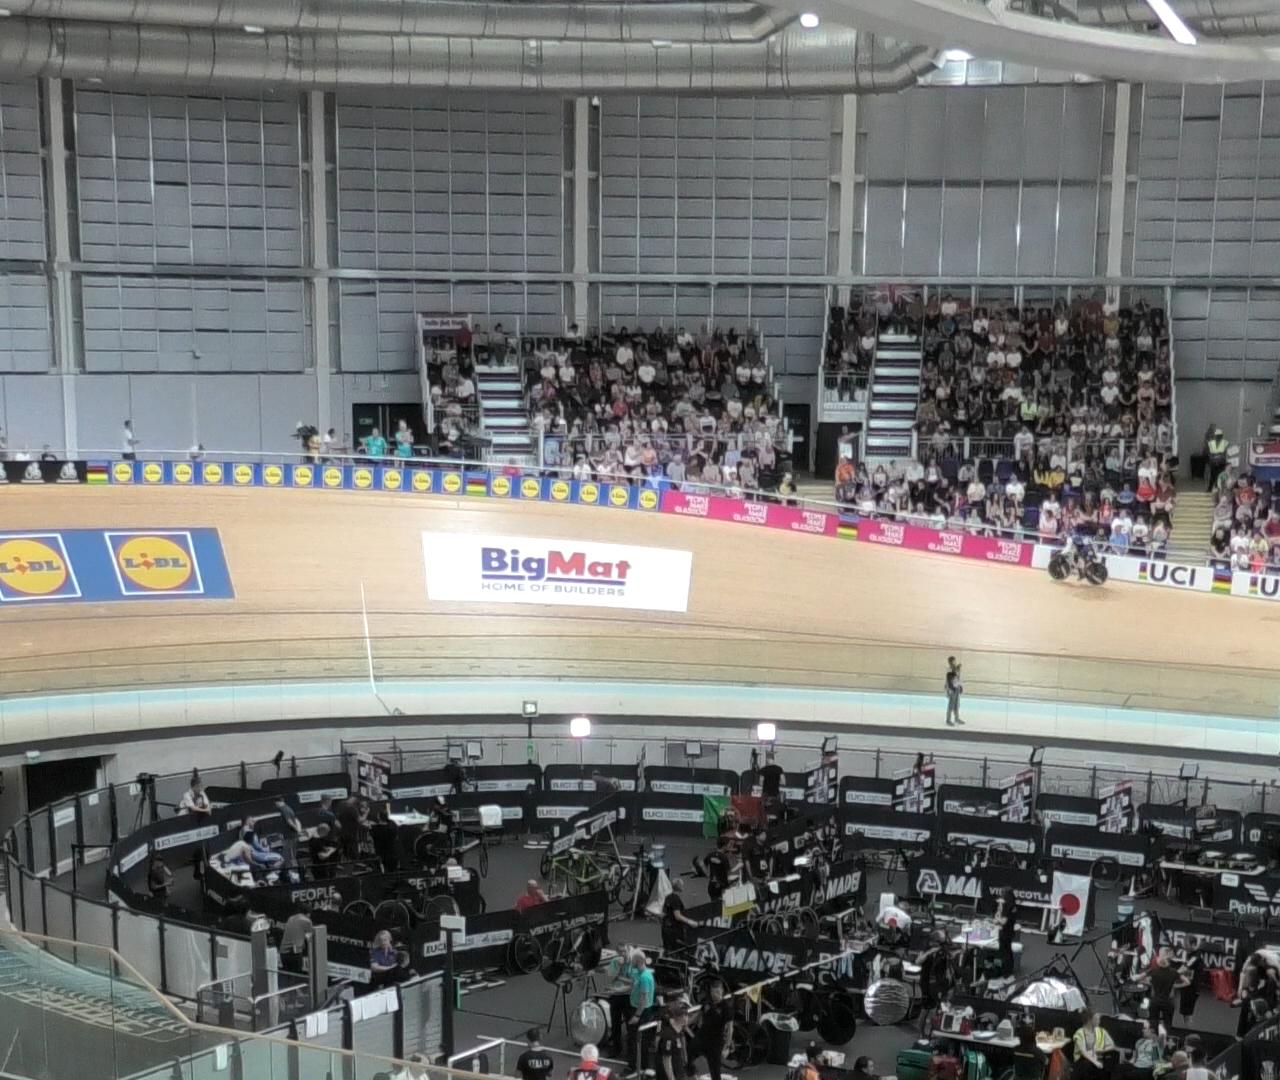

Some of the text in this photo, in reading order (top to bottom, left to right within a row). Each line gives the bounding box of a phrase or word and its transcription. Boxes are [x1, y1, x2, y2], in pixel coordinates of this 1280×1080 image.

[686, 495, 708, 504] PEOPLE
[674, 507, 708, 515] GLASGOW
[744, 503, 768, 512] PEOPLE
[733, 514, 766, 523] GLASGOW
[803, 512, 827, 521] PEOPLE
[791, 522, 825, 533] GLASGOW
[880, 523, 905, 533] PEOPLE
[869, 534, 903, 544] GLASGOW
[939, 532, 963, 542] PEOPLE
[928, 543, 961, 553] GLASGOW
[998, 541, 1022, 551] PEOPLE
[986, 552, 1020, 562] GLASGOW
[481, 547, 631, 581] BigMat
[1149, 562, 1196, 586] UCI
[481, 581, 625, 597] HOME OF BUILDERS
[1229, 900, 1266, 914] Peter
